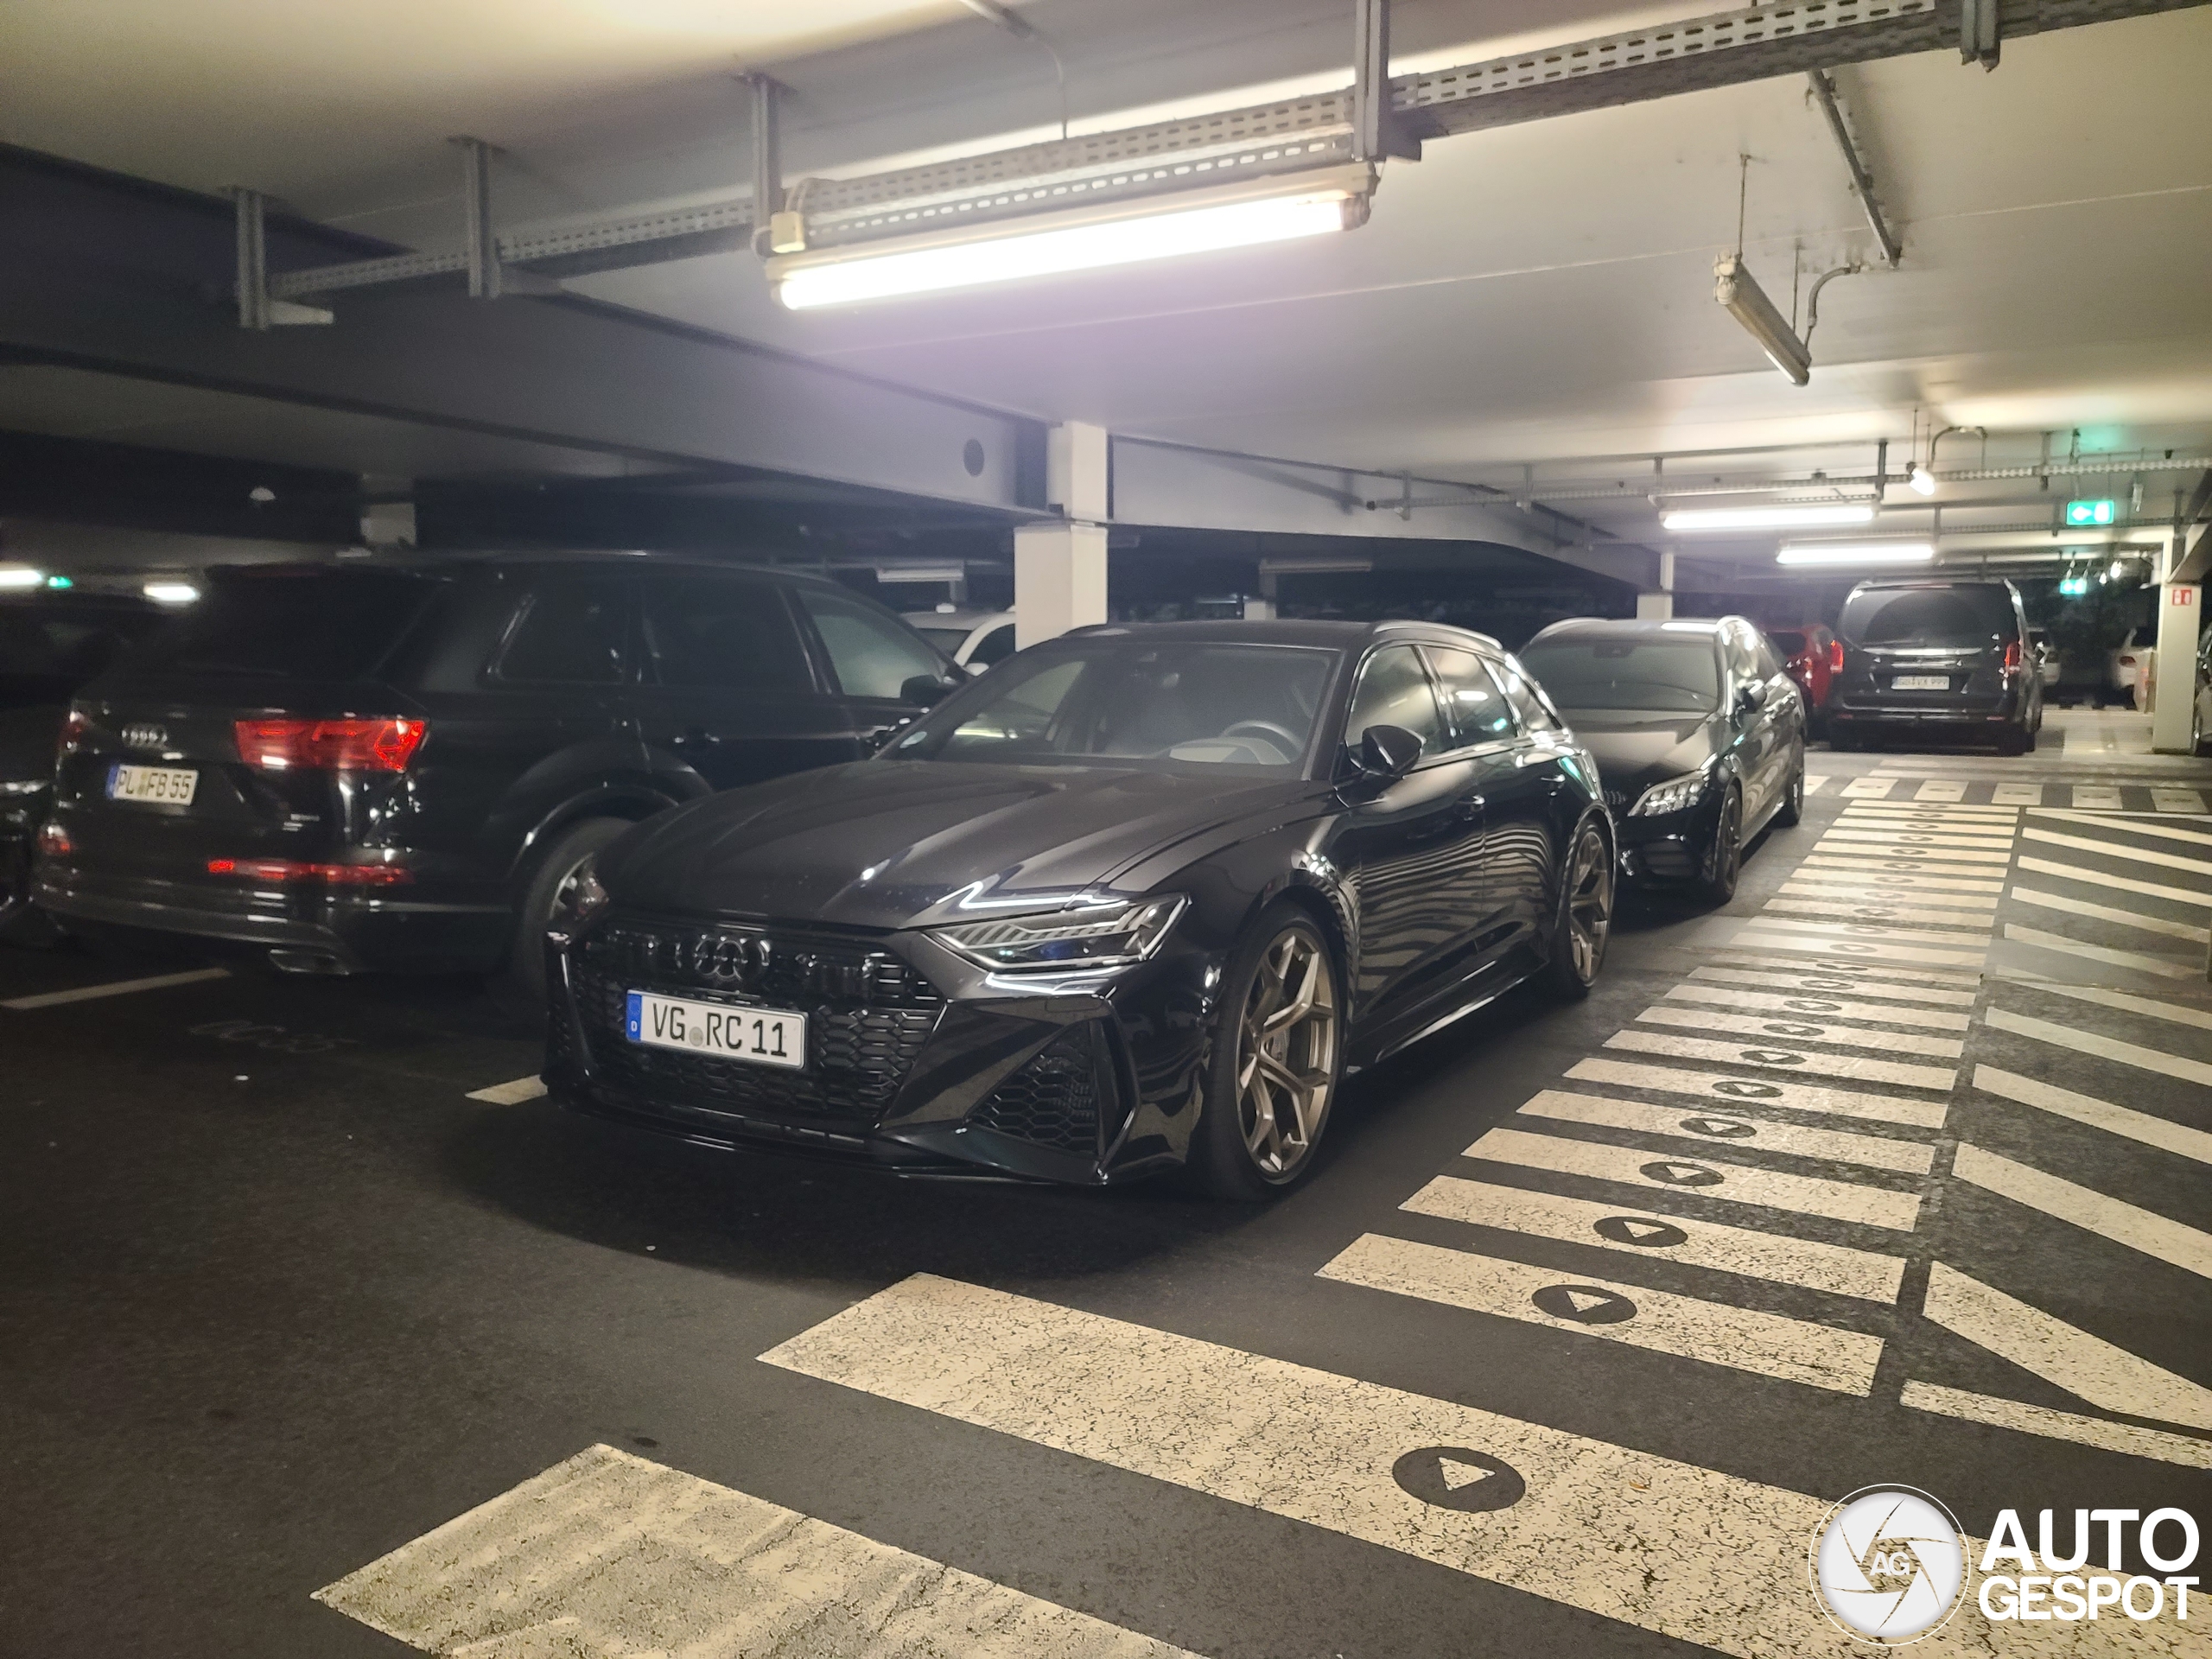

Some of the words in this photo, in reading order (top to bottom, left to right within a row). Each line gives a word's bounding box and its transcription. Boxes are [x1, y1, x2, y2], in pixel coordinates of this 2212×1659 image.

[115, 770, 134, 794] PL
[145, 772, 168, 797] FB
[169, 774, 192, 799] 55
[653, 1002, 685, 1041] VG
[707, 1012, 741, 1049] RC
[751, 1020, 787, 1058] 11
